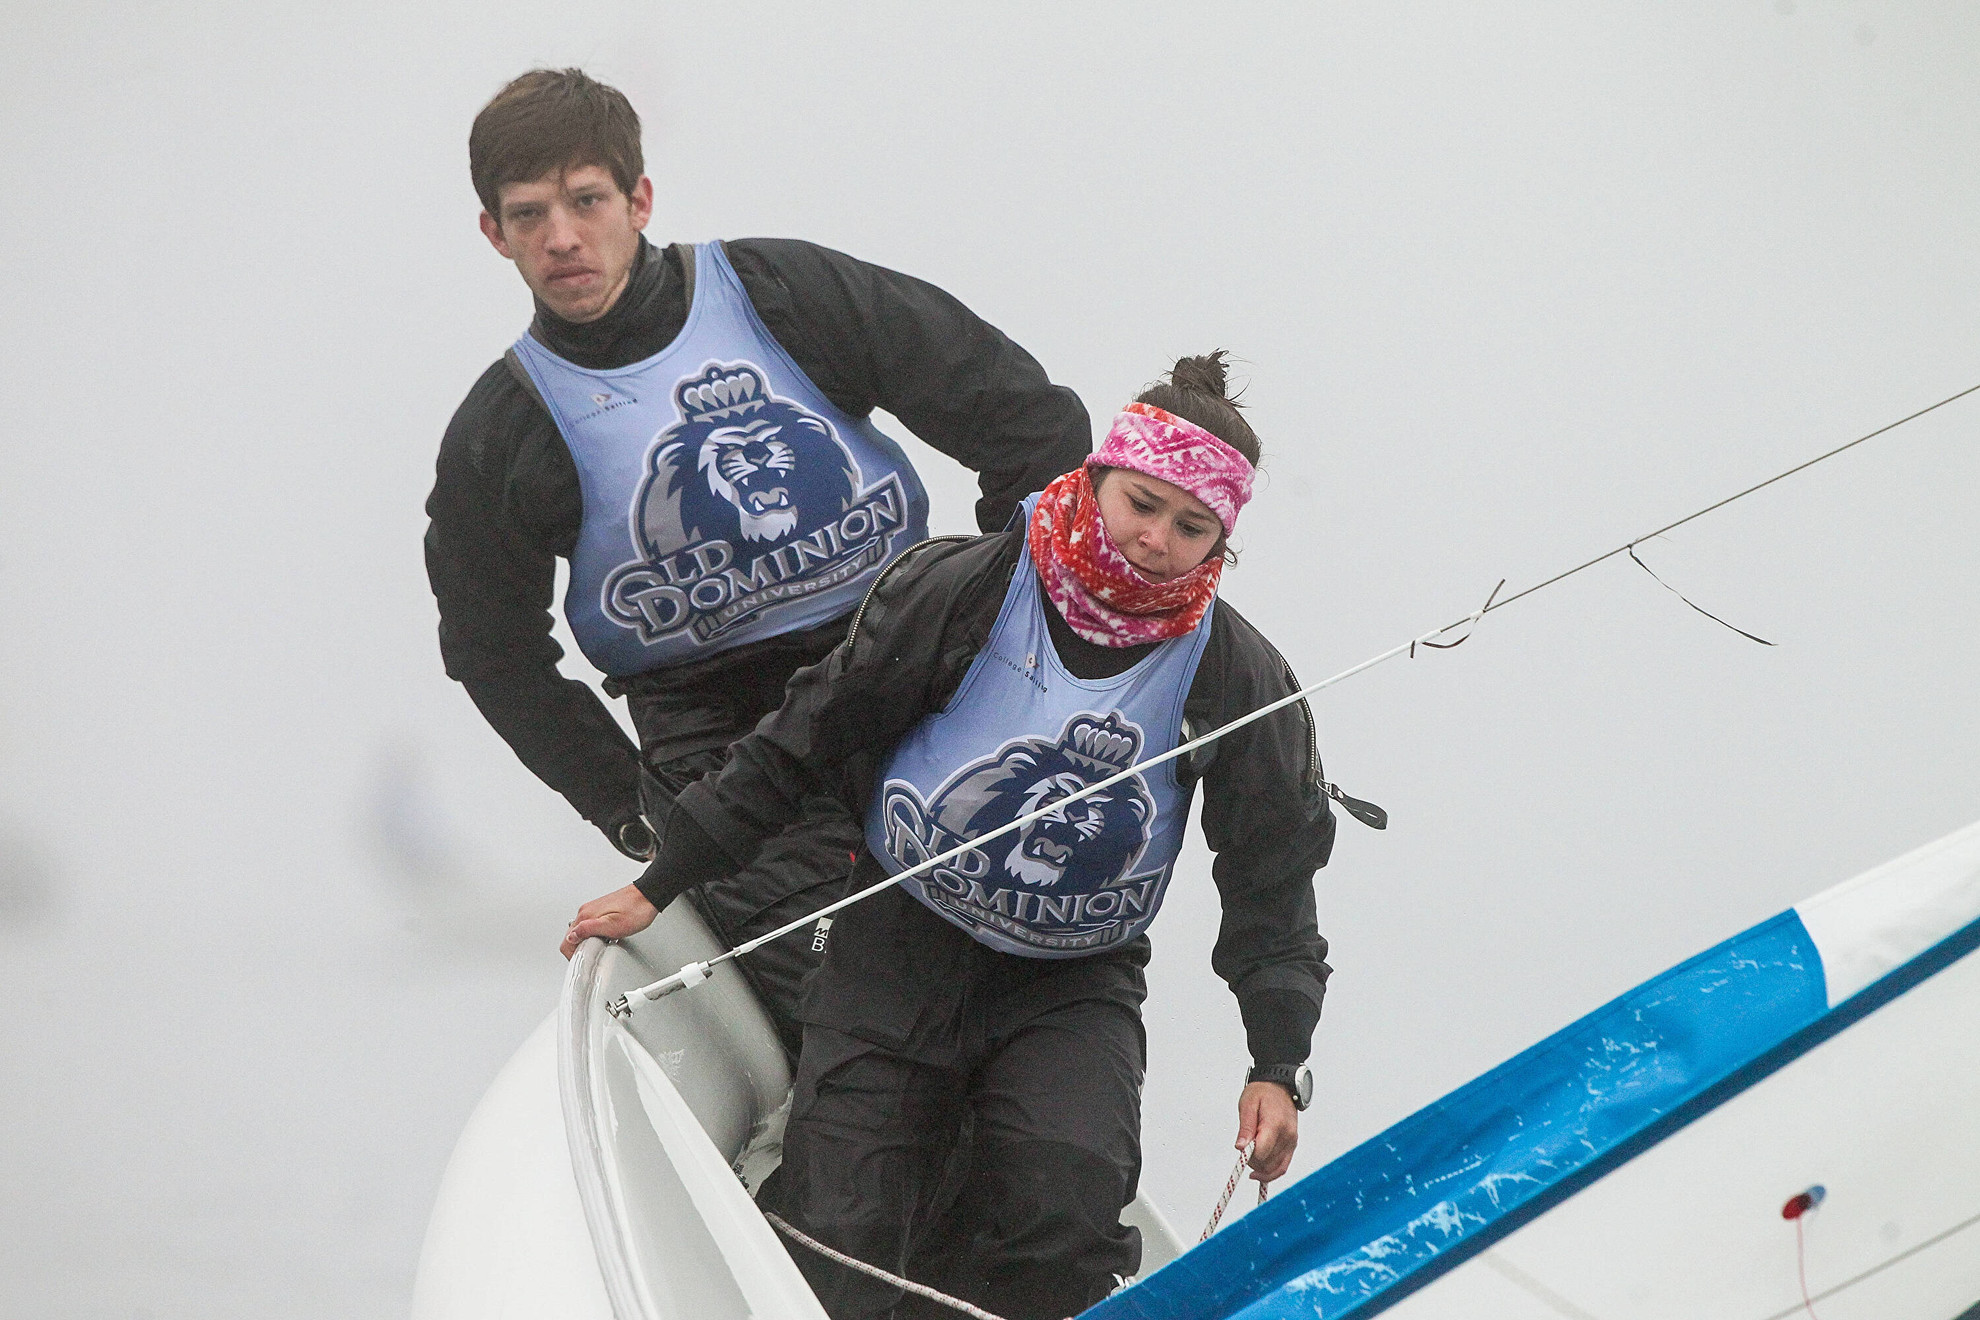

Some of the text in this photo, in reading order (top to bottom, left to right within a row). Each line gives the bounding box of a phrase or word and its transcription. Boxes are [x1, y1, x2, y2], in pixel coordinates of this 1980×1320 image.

[611, 539, 734, 618] OLD
[625, 488, 898, 633] DOMINION
[723, 554, 863, 618] UNIVERSITY
[891, 809, 1154, 925] DOMINION
[955, 900, 1096, 947] UNIVERSITY
